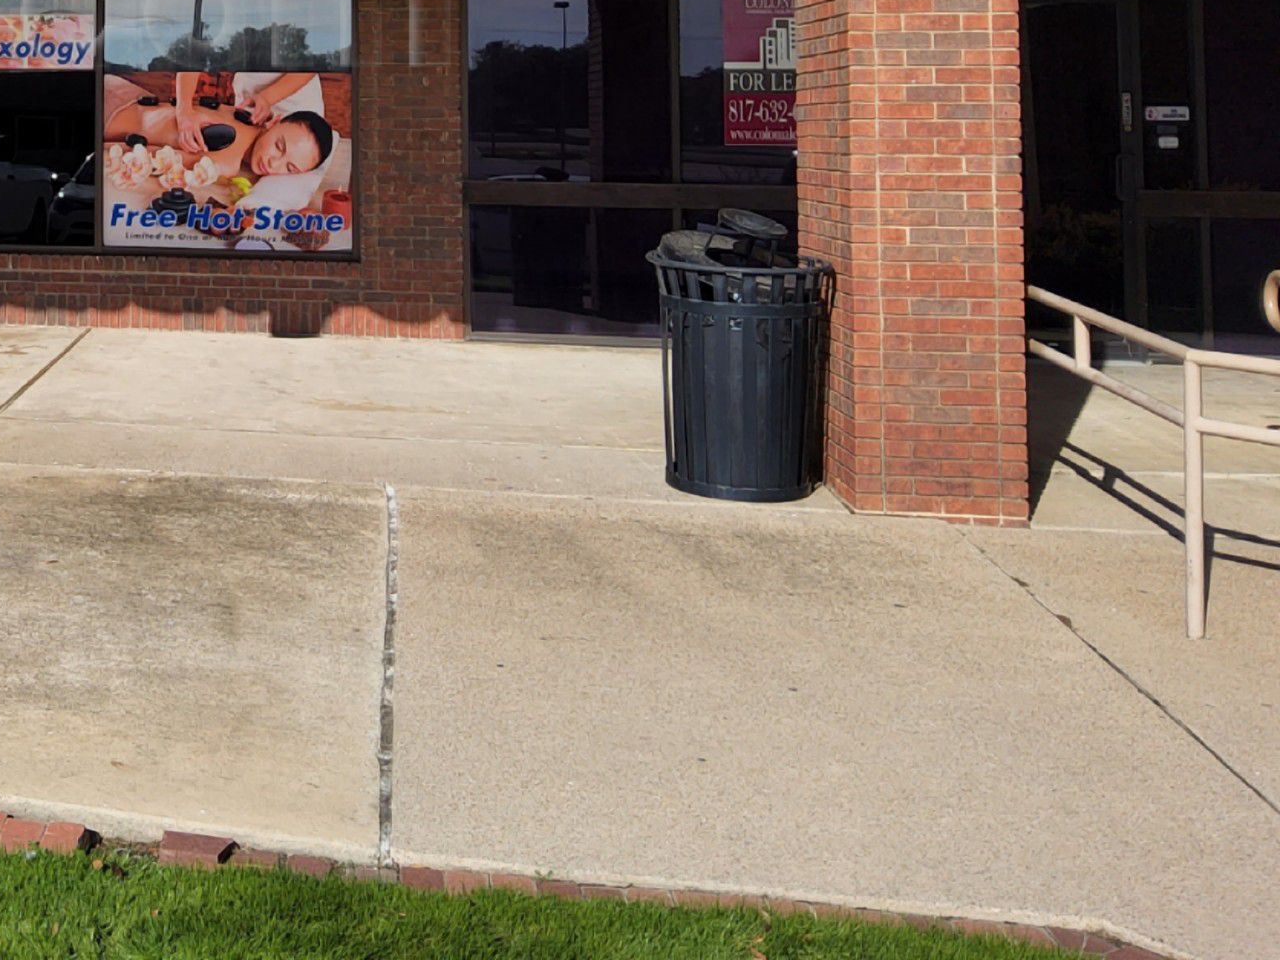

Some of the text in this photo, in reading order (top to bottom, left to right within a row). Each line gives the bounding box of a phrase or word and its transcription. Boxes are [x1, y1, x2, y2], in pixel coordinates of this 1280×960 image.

[729, 71, 766, 91] FOR
[110, 203, 345, 233] Free Hot Stone
